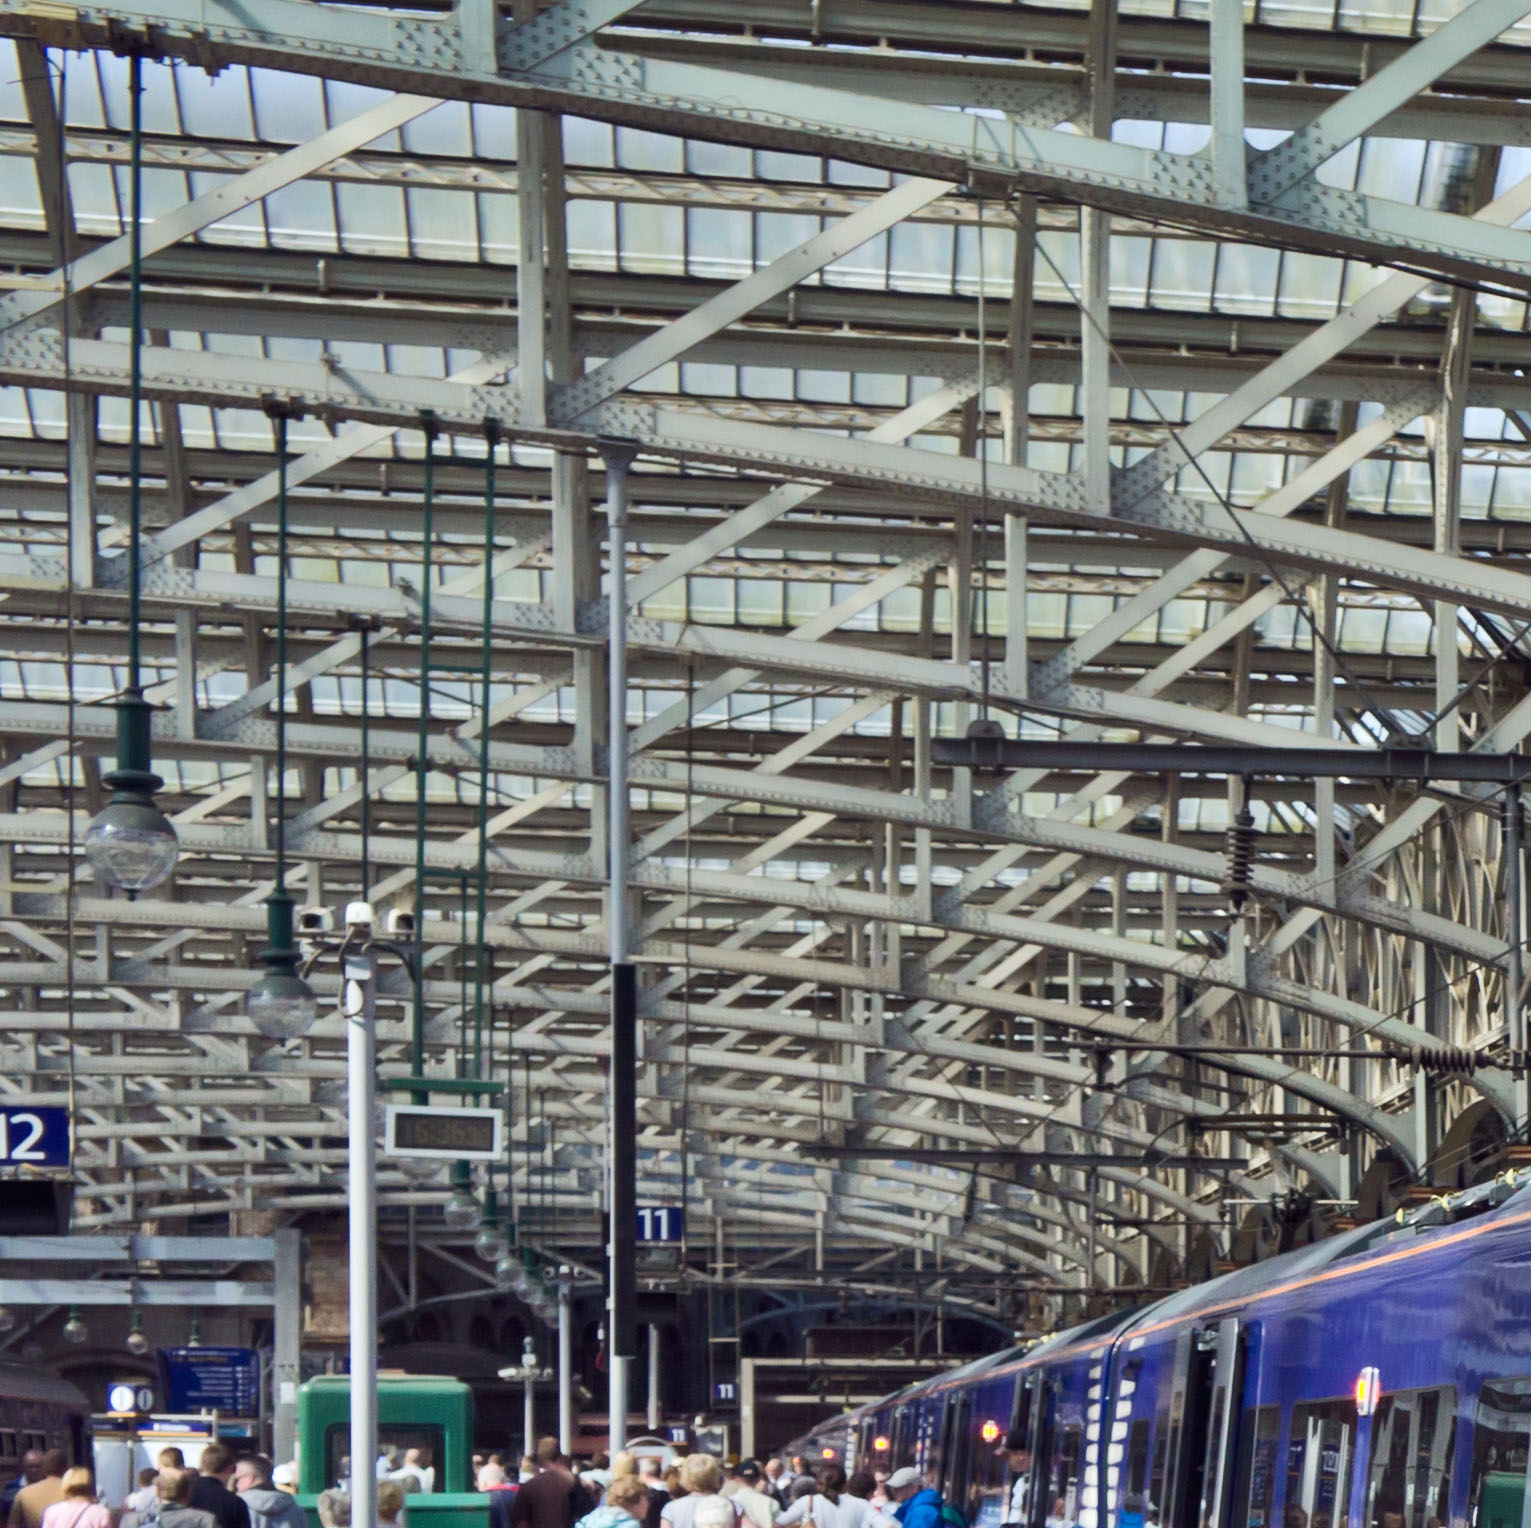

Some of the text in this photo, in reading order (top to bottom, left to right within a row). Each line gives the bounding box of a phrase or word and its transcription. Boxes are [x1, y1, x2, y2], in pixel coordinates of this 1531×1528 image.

[637, 1208, 668, 1240] 11
[718, 1384, 733, 1399] 11
[671, 1428, 685, 1442] 11
